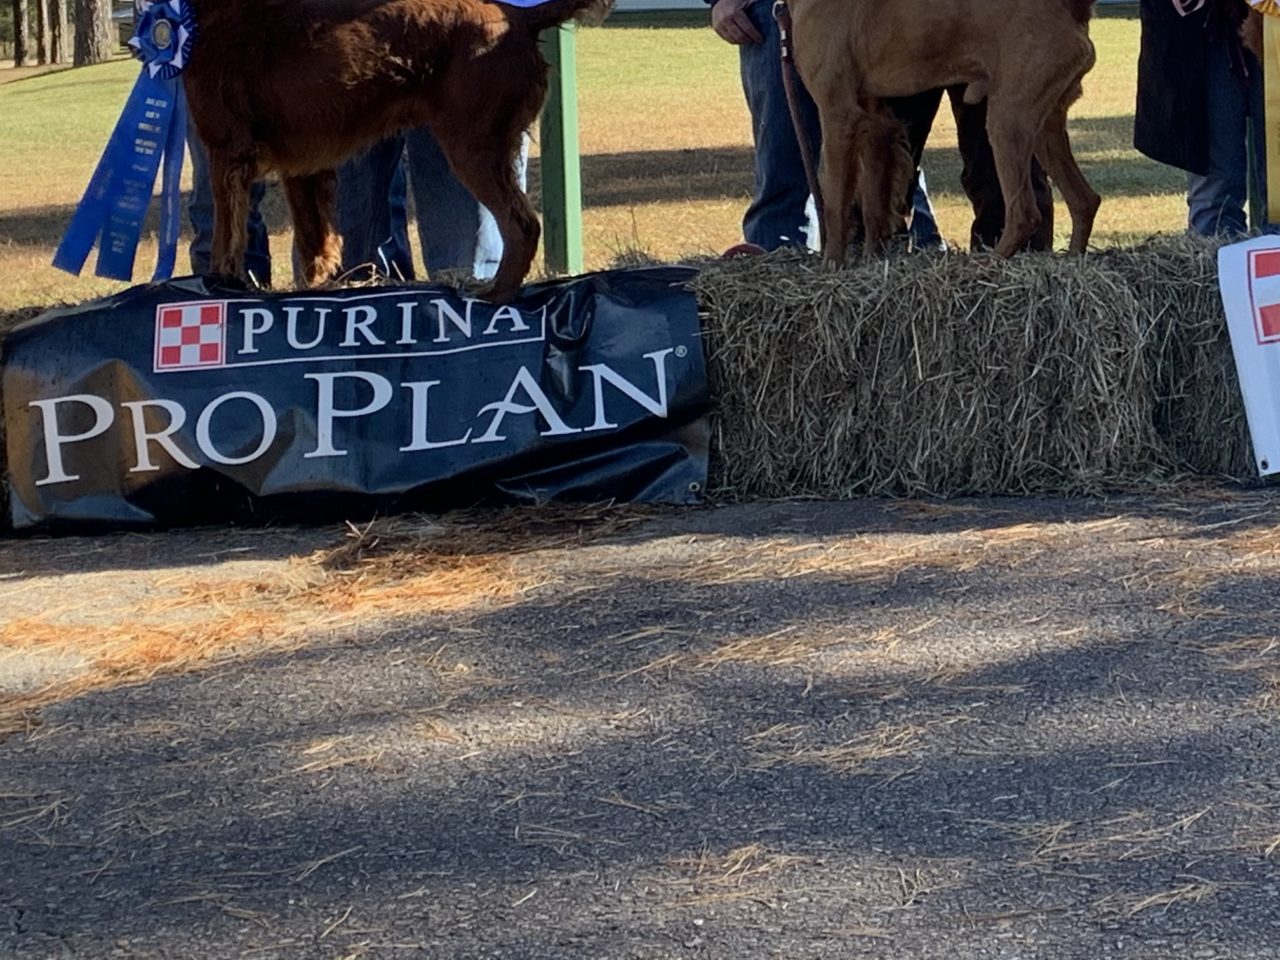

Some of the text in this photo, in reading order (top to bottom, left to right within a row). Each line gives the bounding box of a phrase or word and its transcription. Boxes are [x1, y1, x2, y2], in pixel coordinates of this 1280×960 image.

[237, 298, 530, 353] PURINA
[29, 348, 674, 487] PRO PLAN
